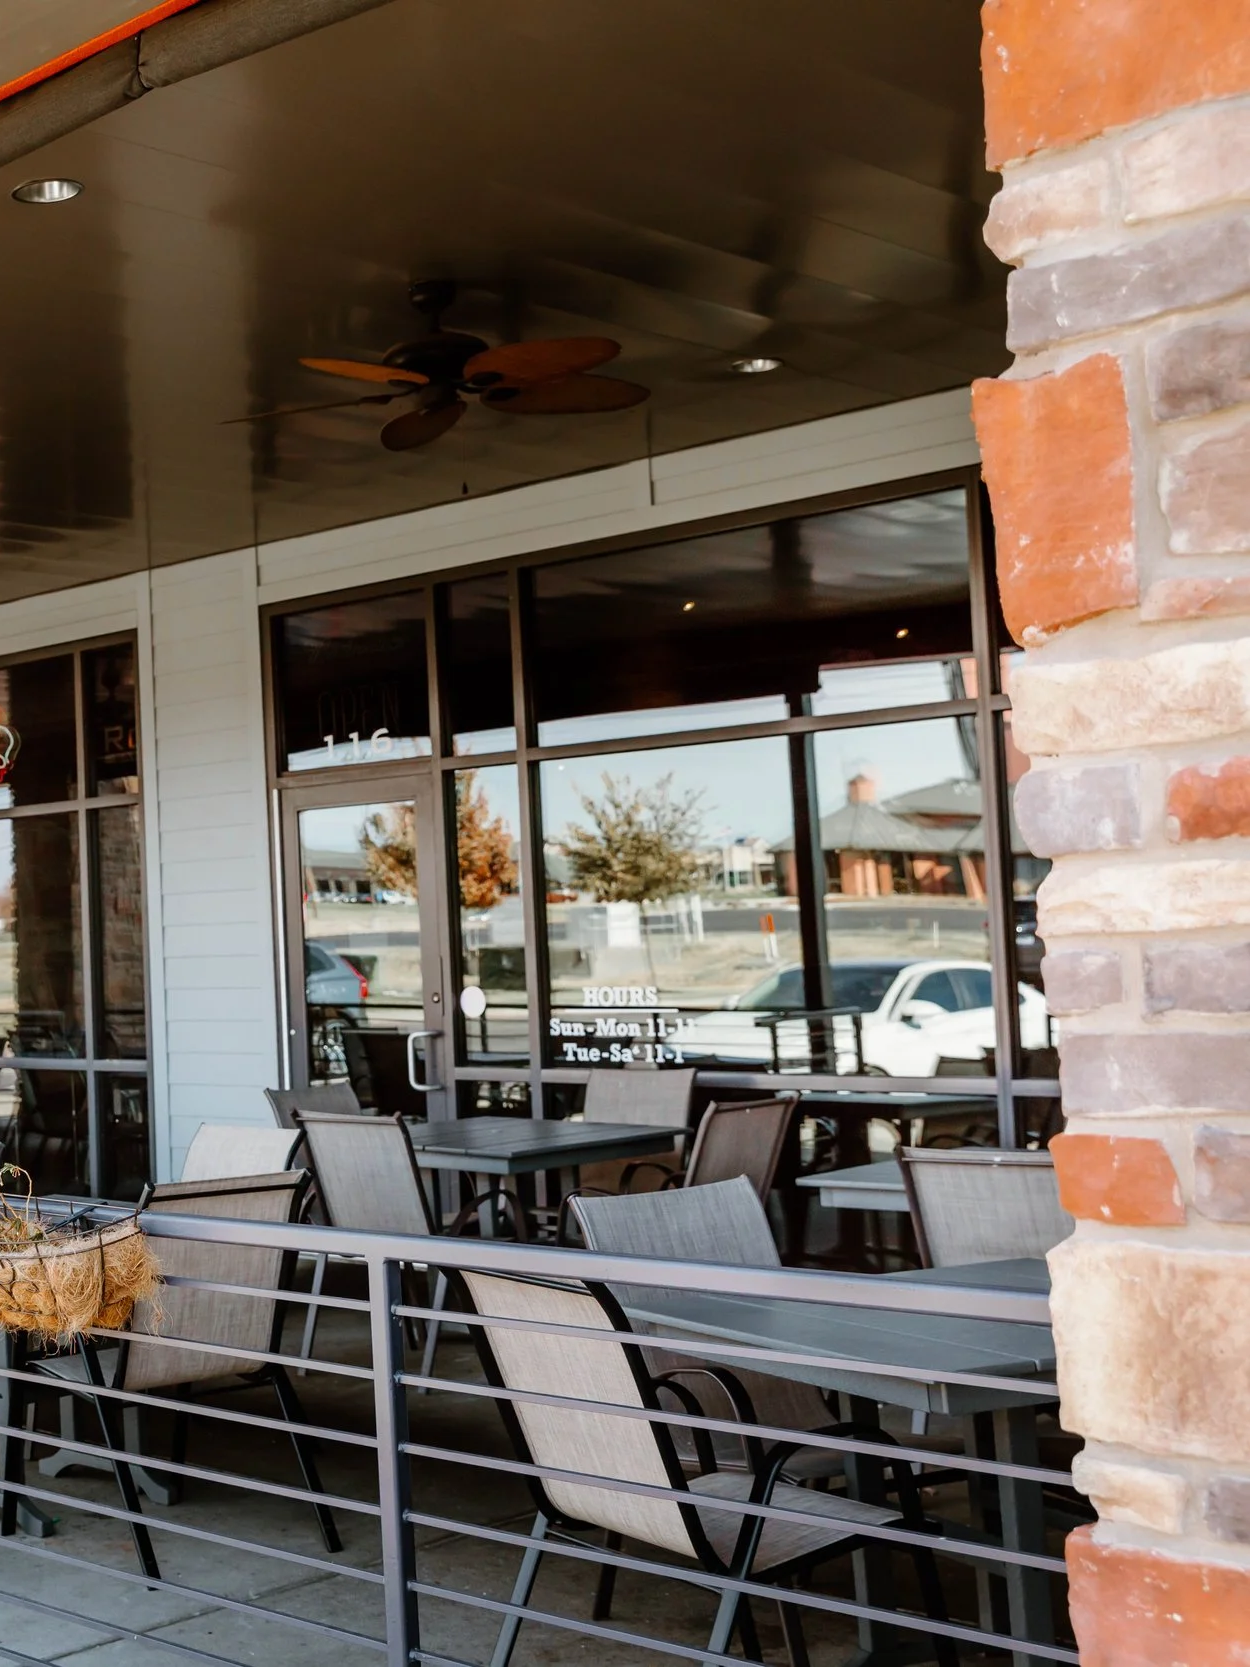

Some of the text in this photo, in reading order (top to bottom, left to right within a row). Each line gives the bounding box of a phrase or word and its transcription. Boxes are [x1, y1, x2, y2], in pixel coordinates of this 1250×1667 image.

[323, 727, 392, 758] 116
[582, 986, 658, 1007] HOURS
[549, 1017, 642, 1037] Sun-Mon
